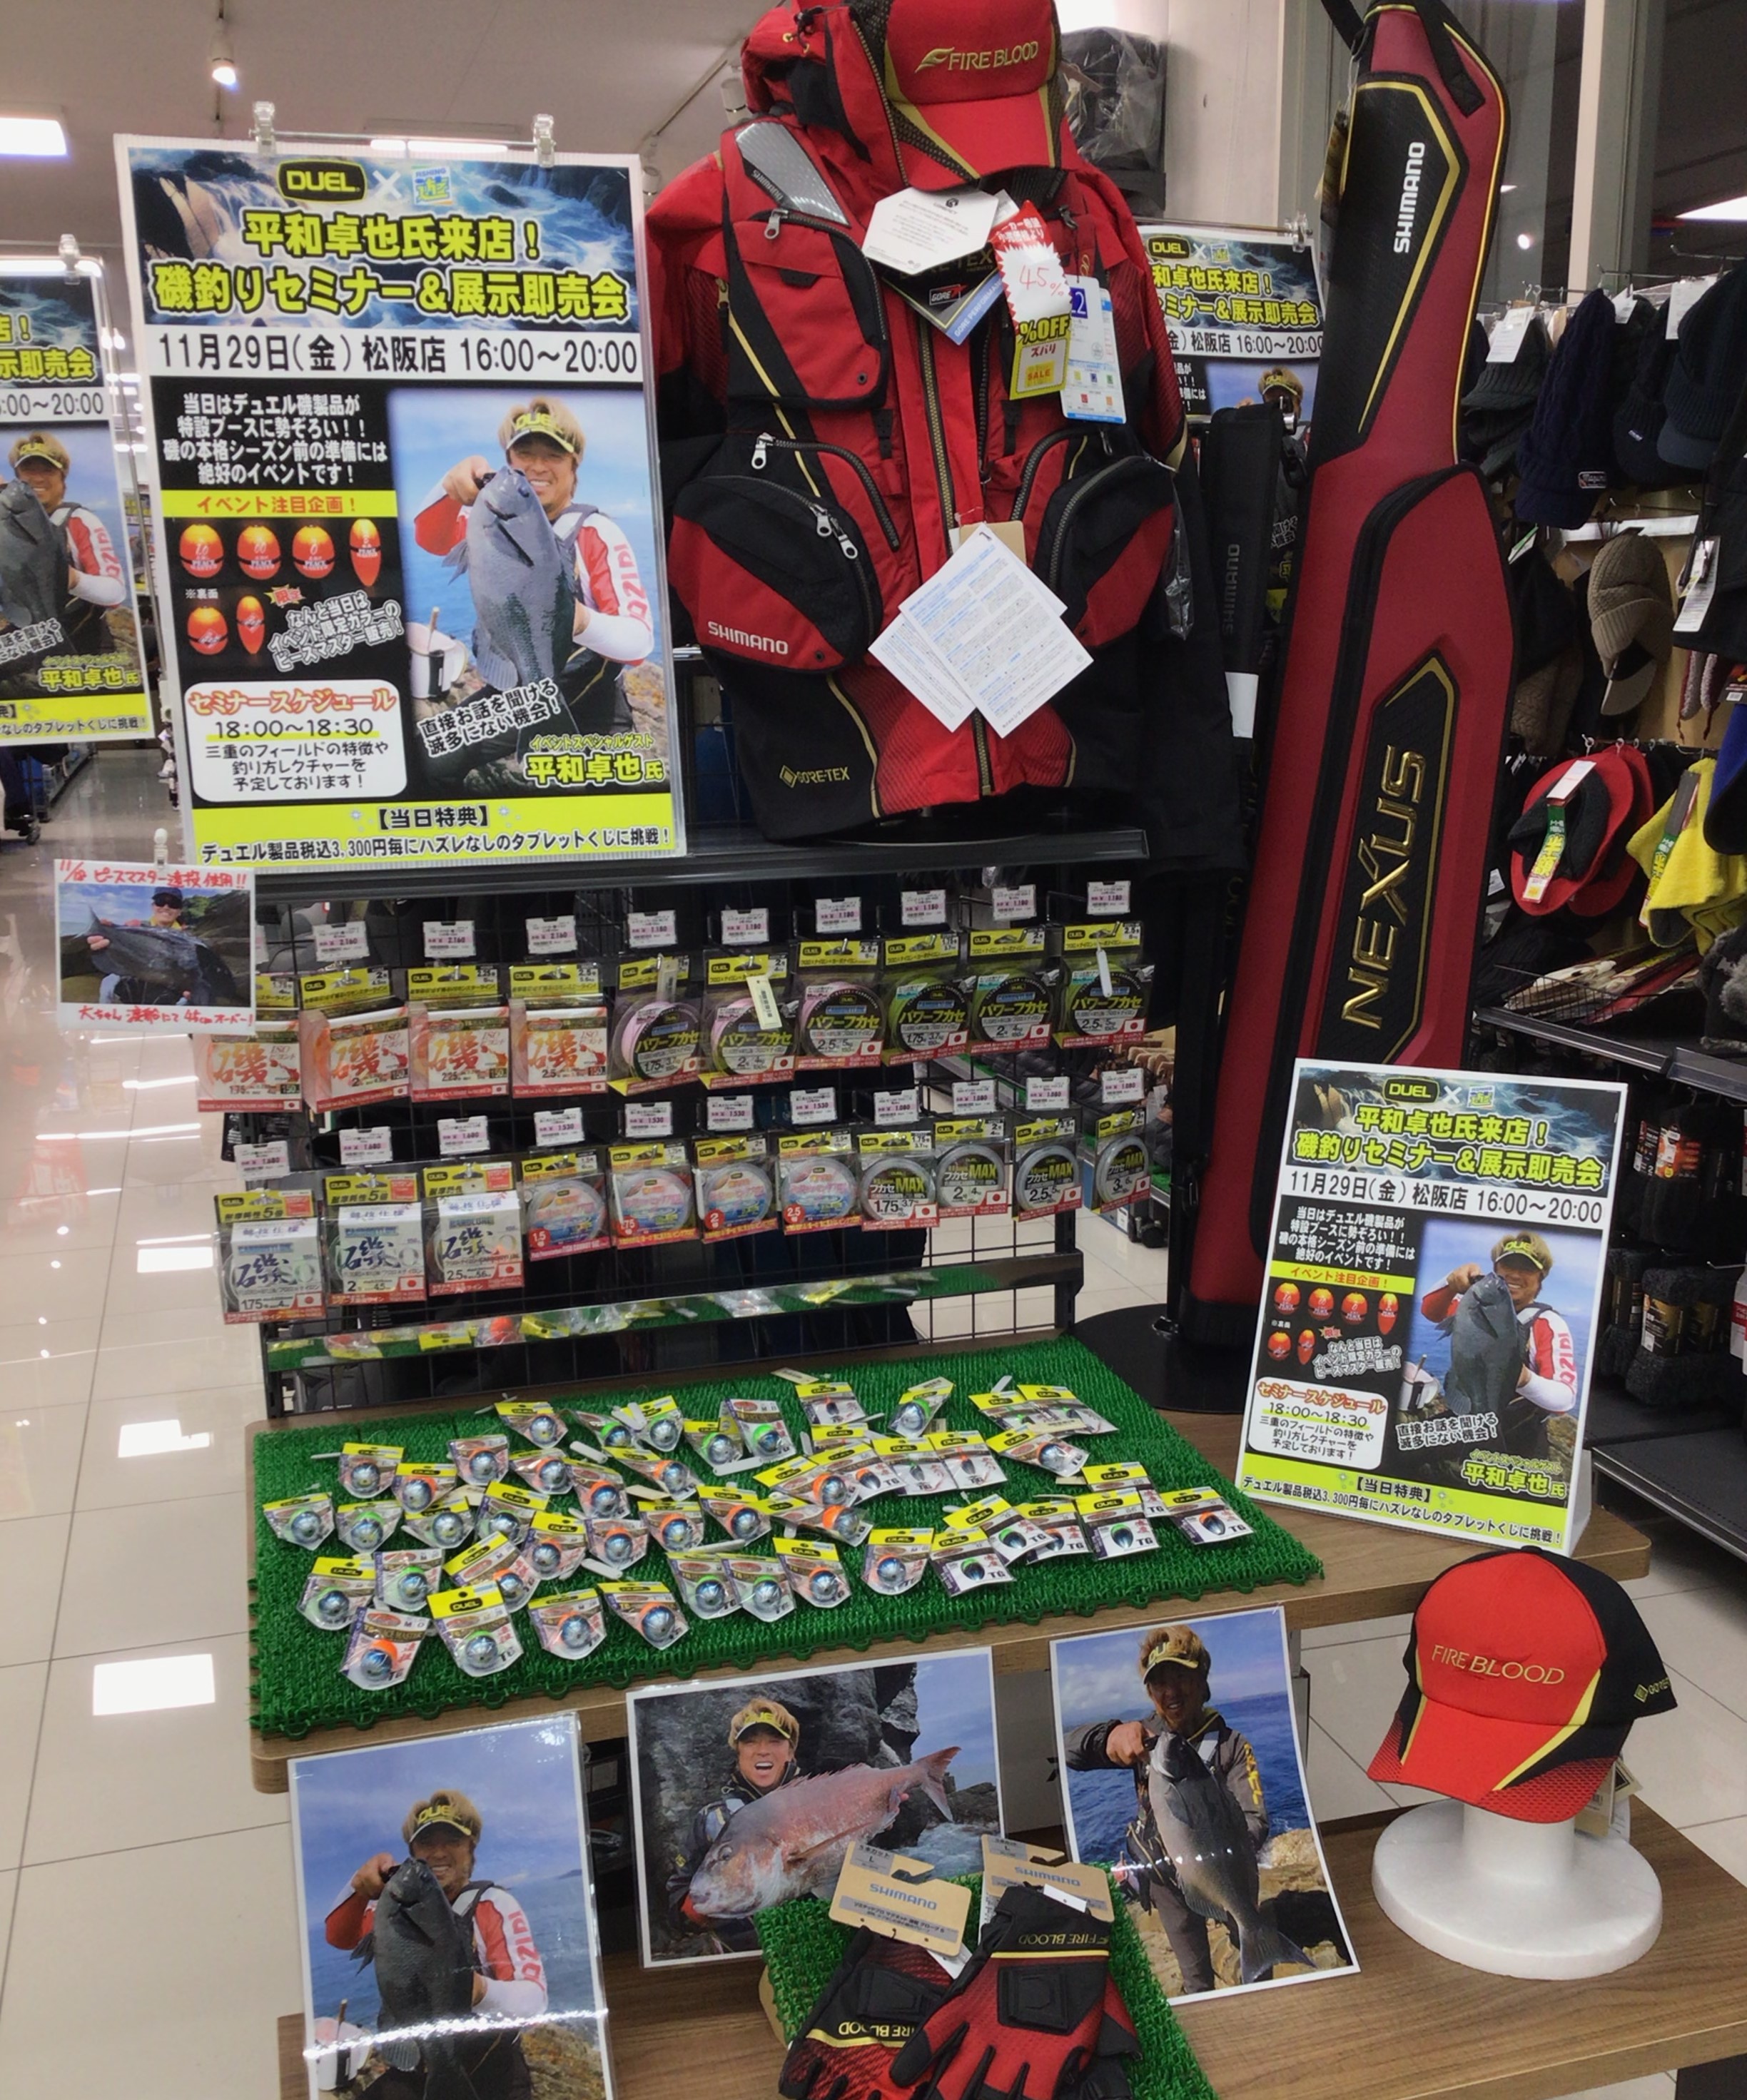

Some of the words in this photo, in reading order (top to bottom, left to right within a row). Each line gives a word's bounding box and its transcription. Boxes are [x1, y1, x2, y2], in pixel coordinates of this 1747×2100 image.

[948, 50, 990, 70] FIRE
[993, 41, 1039, 67] BLOOD
[286, 171, 358, 192] DUEL
[1394, 141, 1426, 253] SHIMANO
[243, 211, 540, 260] 平和卓也氏来店！
[1152, 242, 1187, 254] DUEL
[153, 265, 629, 318] 磯釣りセミナー＆展示即売会
[363, 337, 447, 373] 松阪店
[1028, 369, 1050, 380] SALE
[183, 392, 360, 416] 当日はデュエル磯製品が
[163, 440, 387, 464] 磯の本格シーズン前の準備には
[198, 464, 353, 486] 絶好のイベントです！
[197, 496, 355, 514] イベント注目企画！
[287, 593, 369, 628] なんと当日は
[708, 621, 789, 655] SHIMANO
[189, 688, 396, 716] セミナースケジュール
[420, 679, 558, 738] 直接お話を聞ける
[206, 741, 388, 759] 三重のフィールドの特徴や
[233, 759, 366, 775] 釣り方レクチャーを
[1341, 744, 1426, 1030] NEXUS
[898, 1008, 966, 1024] パワーフカセ
[979, 1002, 1049, 1018] パワーフカセ
[807, 1015, 881, 1030] パワーフカセ
[1389, 1083, 1432, 1100] DUEL
[1355, 1105, 1549, 1147] 平和卓也氏来店！
[1125, 1152, 1145, 1170] MAX
[1295, 1130, 1604, 1189] 磯釣りセミナー＆展示即売会
[969, 1165, 996, 1177] MAX
[1049, 1162, 1074, 1180] MAX
[896, 1177, 925, 1192] MAX
[1412, 1182, 1469, 1210] 松阪店
[1290, 1267, 1388, 1288] イベント注目企画！
[1257, 1382, 1386, 1415] セミナースケジュール
[1398, 1414, 1497, 1438] 直接お話を聞ける
[1273, 1429, 1357, 1451] 釣り方レクチャーを
[1095, 1499, 1123, 1508] DUEL
[967, 1508, 994, 1525] DUEL
[939, 1536, 968, 1547] DUEL
[1030, 1533, 1048, 1542] TG
[452, 1599, 482, 1610] DUEL
[1432, 1644, 1470, 1668] FIRE
[1470, 1655, 1565, 1685] BLOOD
[1015, 1866, 1081, 1887] SHIMANO
[870, 1883, 938, 1910] SHIMANO
[1019, 1934, 1065, 1945] BLOOD
